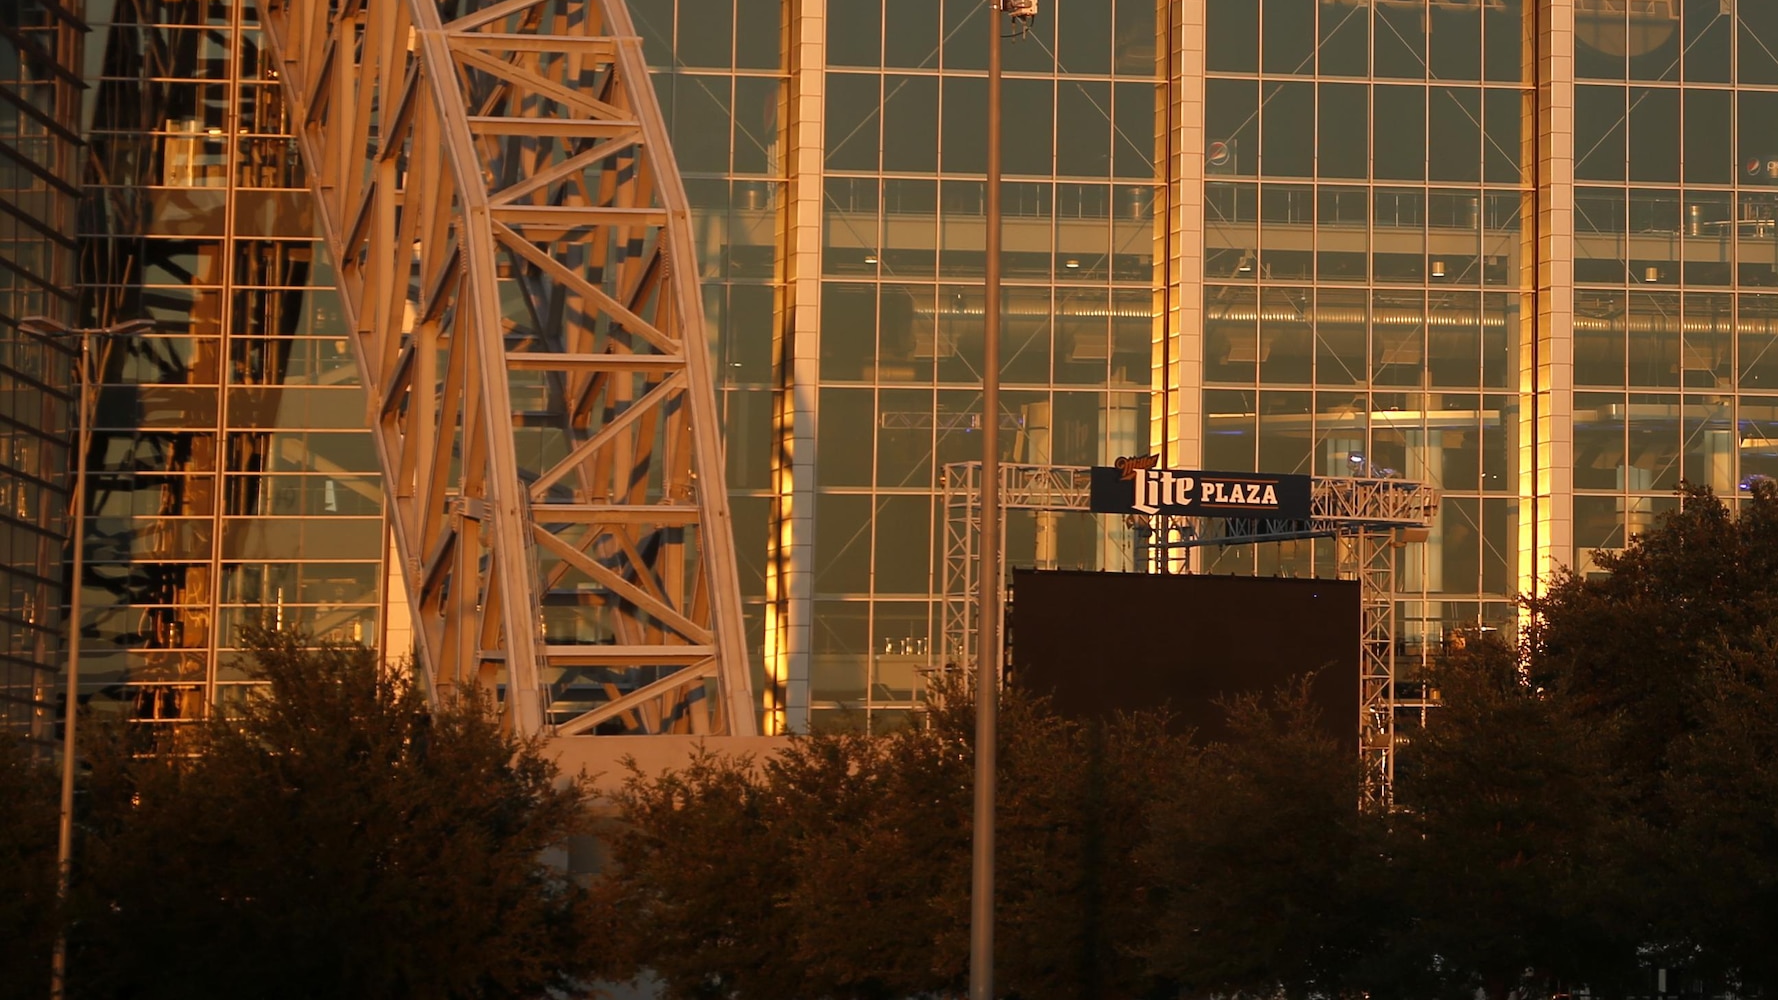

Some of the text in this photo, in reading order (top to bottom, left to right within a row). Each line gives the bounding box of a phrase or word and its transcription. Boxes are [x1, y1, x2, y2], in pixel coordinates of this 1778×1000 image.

[1114, 453, 1160, 480] Miller
[1132, 469, 1278, 514] Lite PLAZA
